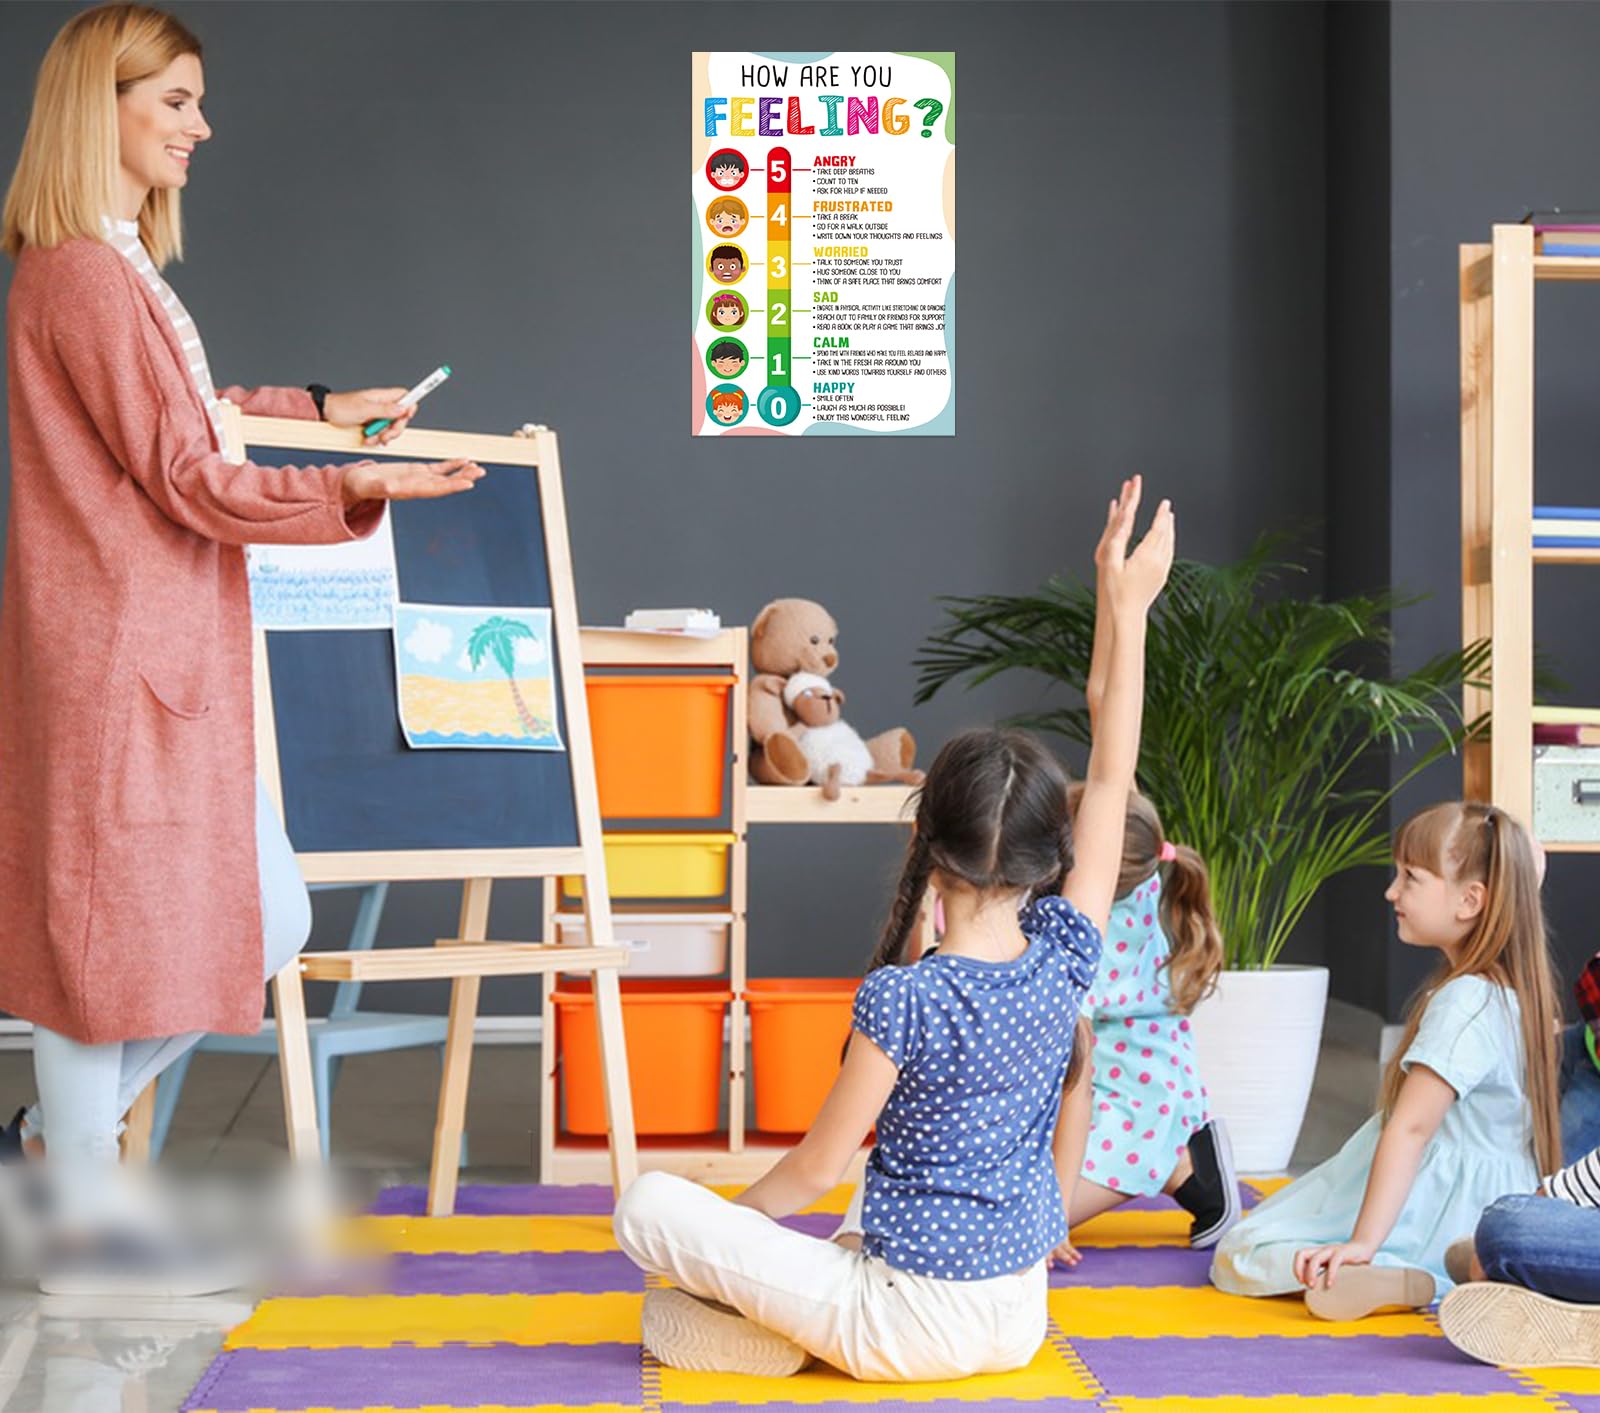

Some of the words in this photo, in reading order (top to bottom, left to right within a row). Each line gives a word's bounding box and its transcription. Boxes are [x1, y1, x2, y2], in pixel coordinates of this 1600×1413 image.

[742, 65, 788, 87] HOW
[800, 65, 839, 87] ARE
[851, 65, 892, 87] YOU
[704, 96, 943, 138] FEELING?
[771, 160, 786, 182] 5
[813, 156, 856, 167] ANGRY
[770, 204, 787, 226] 4
[813, 201, 893, 212] FRUSTRATED
[813, 246, 869, 257] WORRIED
[771, 256, 786, 278] 3
[813, 291, 839, 303] SAD
[771, 303, 786, 325] 2
[813, 337, 850, 348] CALM
[771, 353, 786, 375] 1
[813, 382, 855, 394] HAPPY
[771, 397, 786, 419] 0
